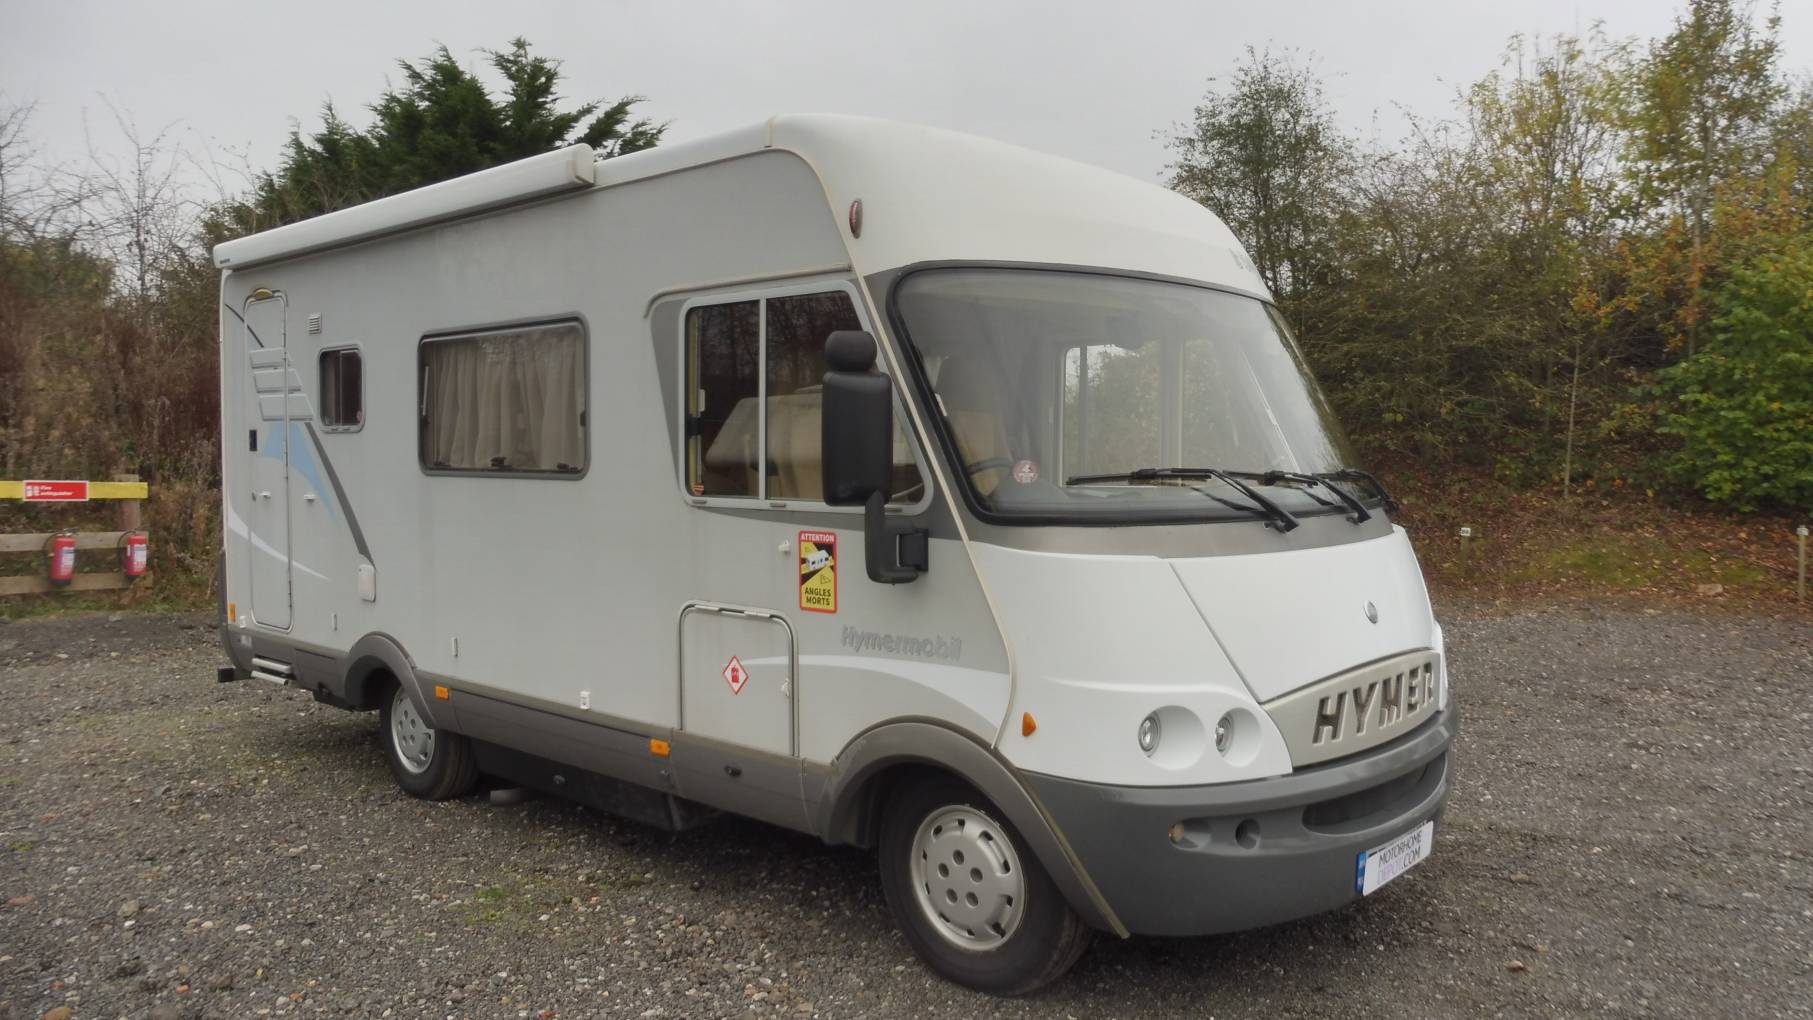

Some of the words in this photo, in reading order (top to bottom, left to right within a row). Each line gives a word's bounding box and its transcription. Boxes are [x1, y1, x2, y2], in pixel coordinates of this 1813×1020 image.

[800, 534, 835, 543] ATTENTION
[804, 587, 831, 597] ANGLES
[806, 595, 831, 606] MORTS
[841, 625, 962, 660] Hymermobil
[1312, 662, 1434, 746] HYMER
[1378, 830, 1422, 867] MOTORHOME
